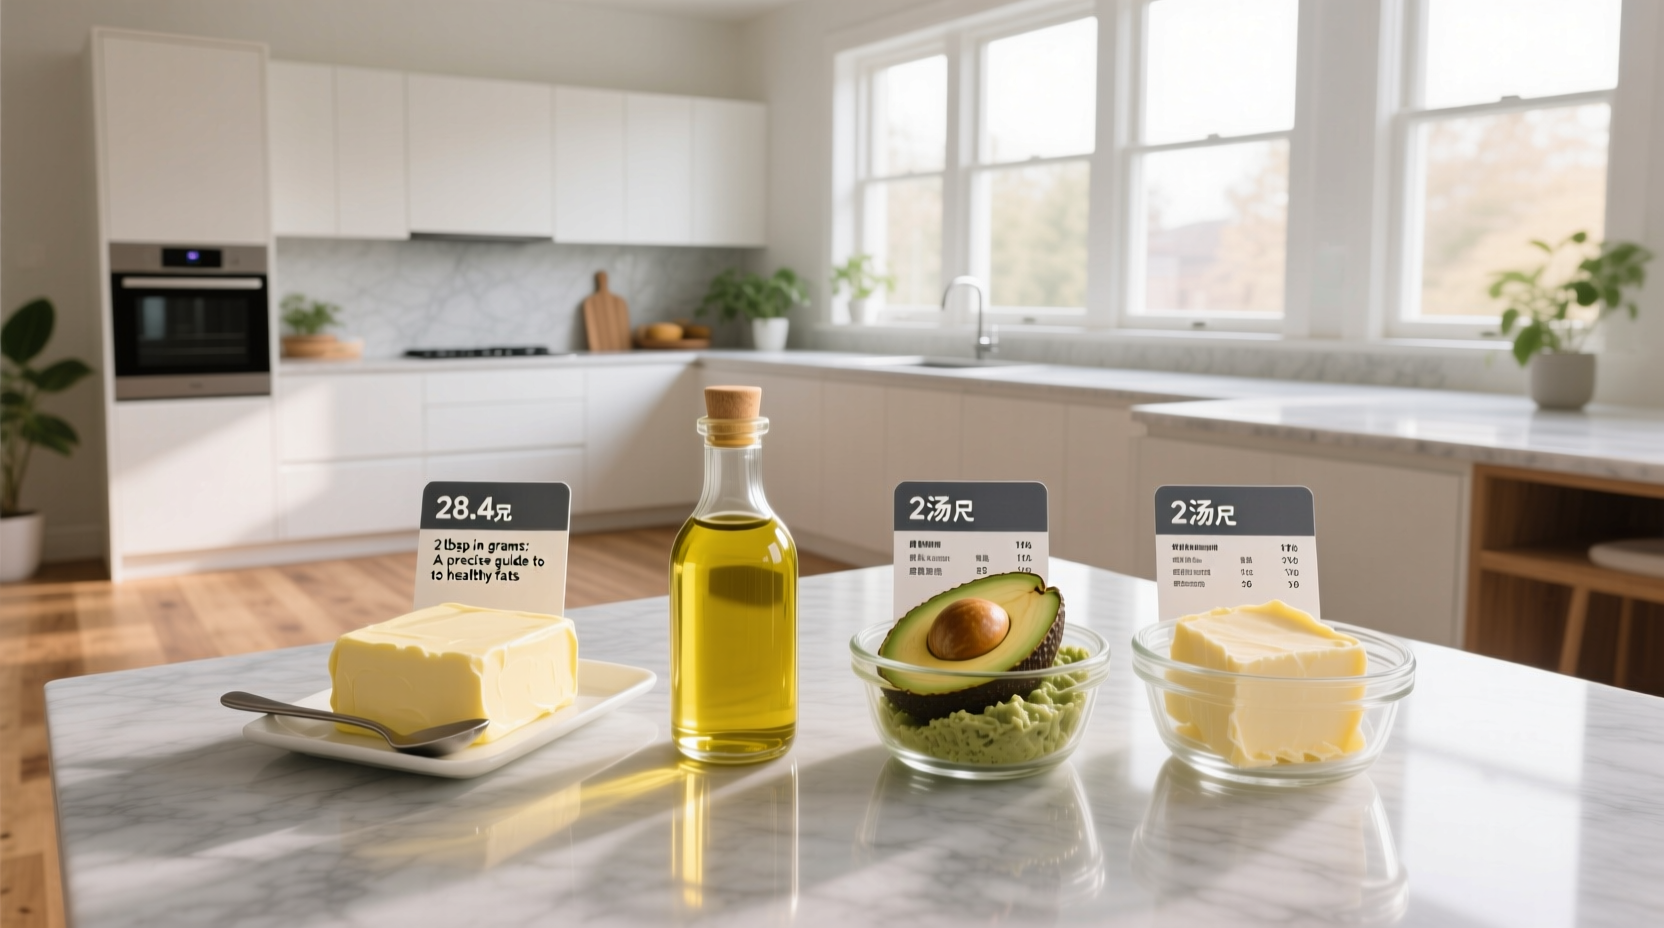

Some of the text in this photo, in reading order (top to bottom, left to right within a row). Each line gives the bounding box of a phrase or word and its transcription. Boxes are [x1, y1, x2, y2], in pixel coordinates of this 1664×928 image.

[434, 539, 442, 551] 2
[473, 539, 484, 551] in
[433, 554, 443, 566] A
[533, 555, 545, 567] to
